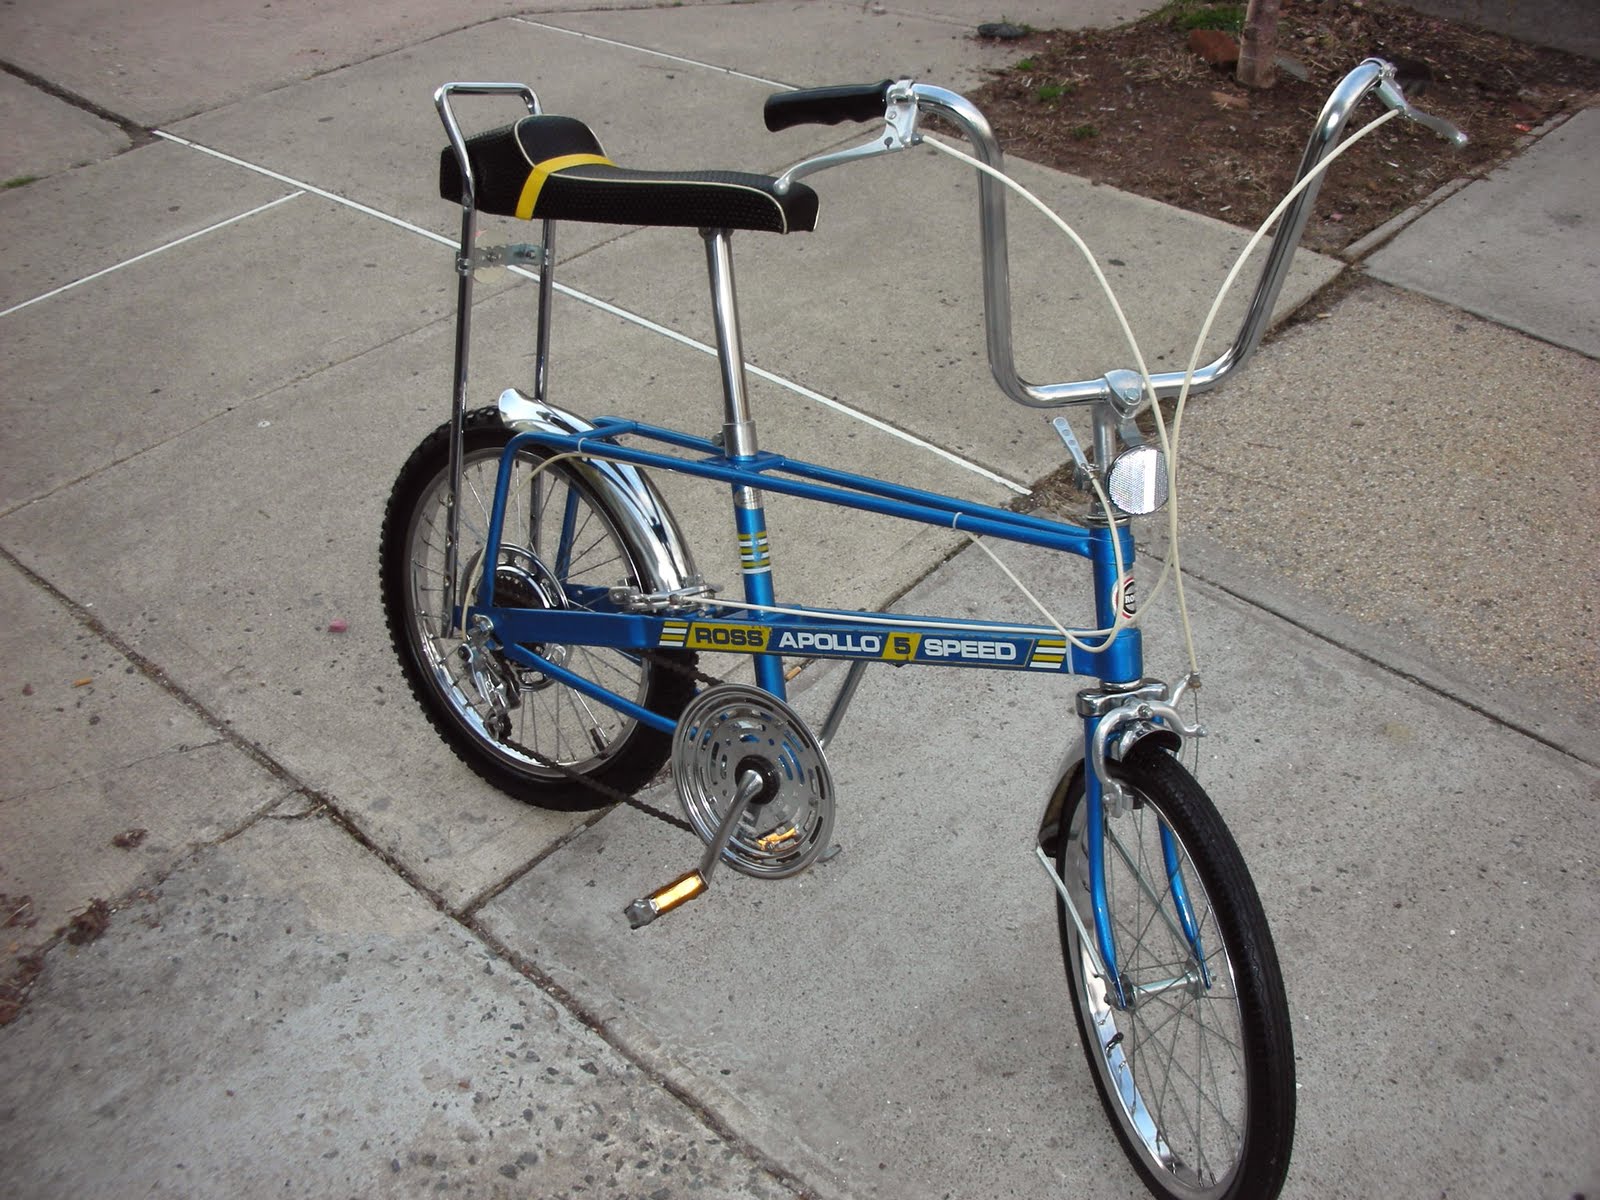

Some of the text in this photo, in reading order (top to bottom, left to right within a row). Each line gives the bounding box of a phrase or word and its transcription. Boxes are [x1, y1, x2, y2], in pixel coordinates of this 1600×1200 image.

[695, 627, 1017, 661] ROSS APOLLO 5 SPEED
